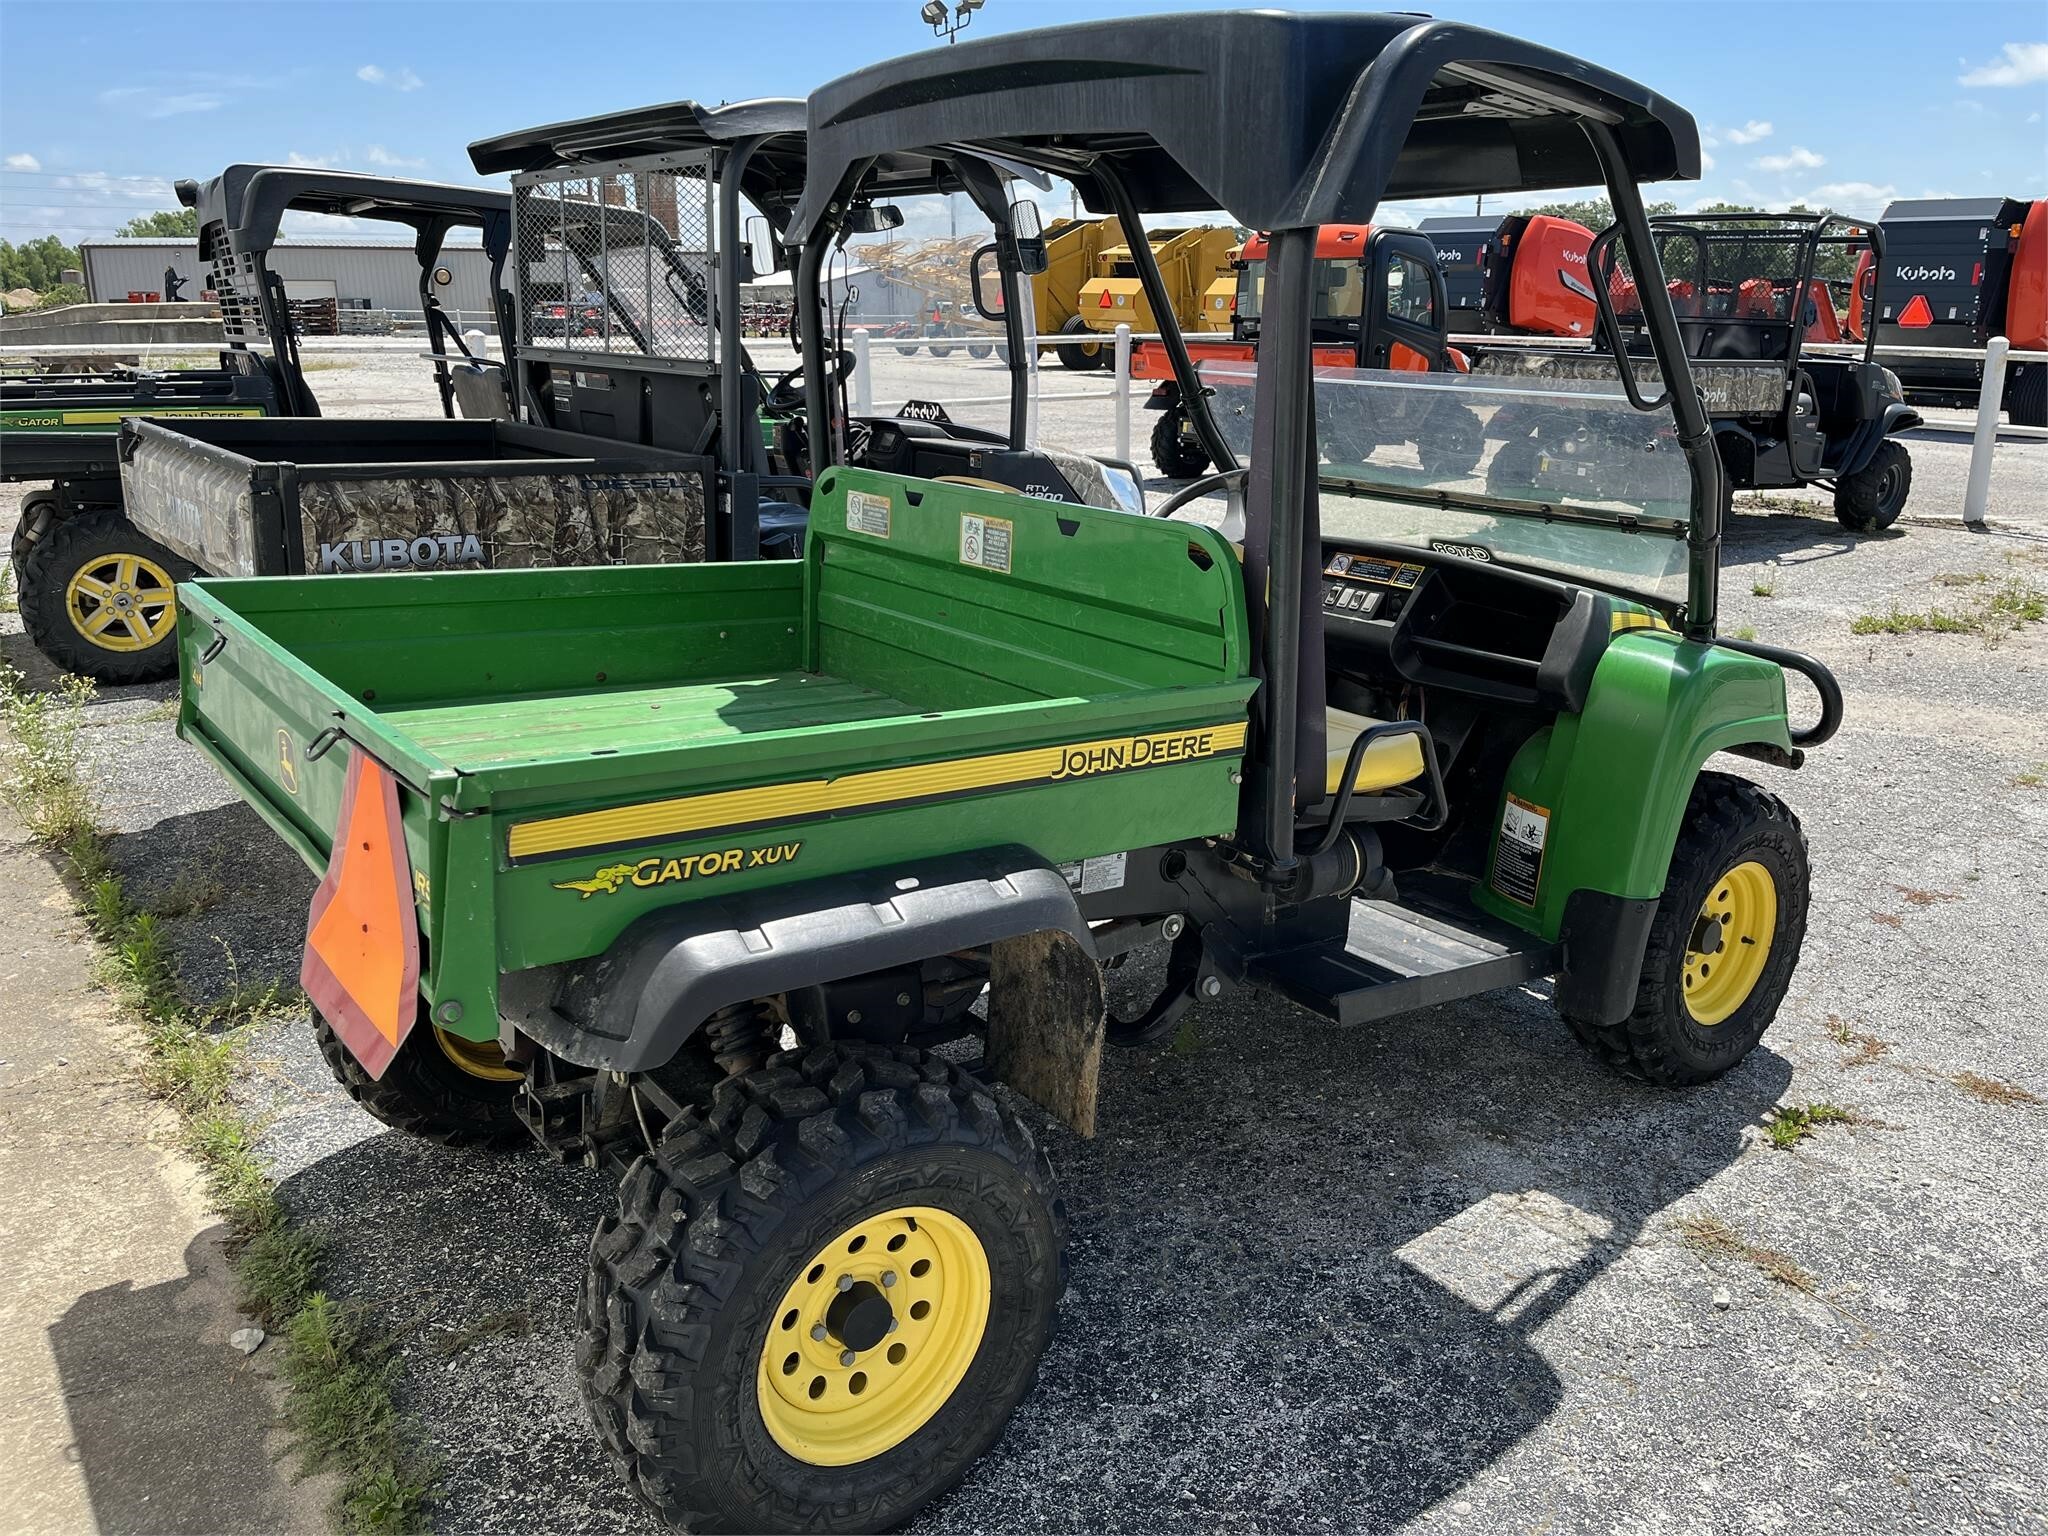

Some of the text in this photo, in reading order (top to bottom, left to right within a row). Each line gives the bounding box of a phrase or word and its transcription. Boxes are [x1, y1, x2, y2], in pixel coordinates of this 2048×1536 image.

[1896, 265, 1956, 281] Kubota
[1704, 387, 1727, 402] bota
[18, 418, 59, 427] GATOR
[581, 478, 690, 492] DIESEL
[1025, 484, 1050, 493] RTV
[320, 534, 488, 573] KUBOTA
[1051, 733, 1213, 777] JOHN DEERE
[632, 843, 801, 887] GATOR XUV
